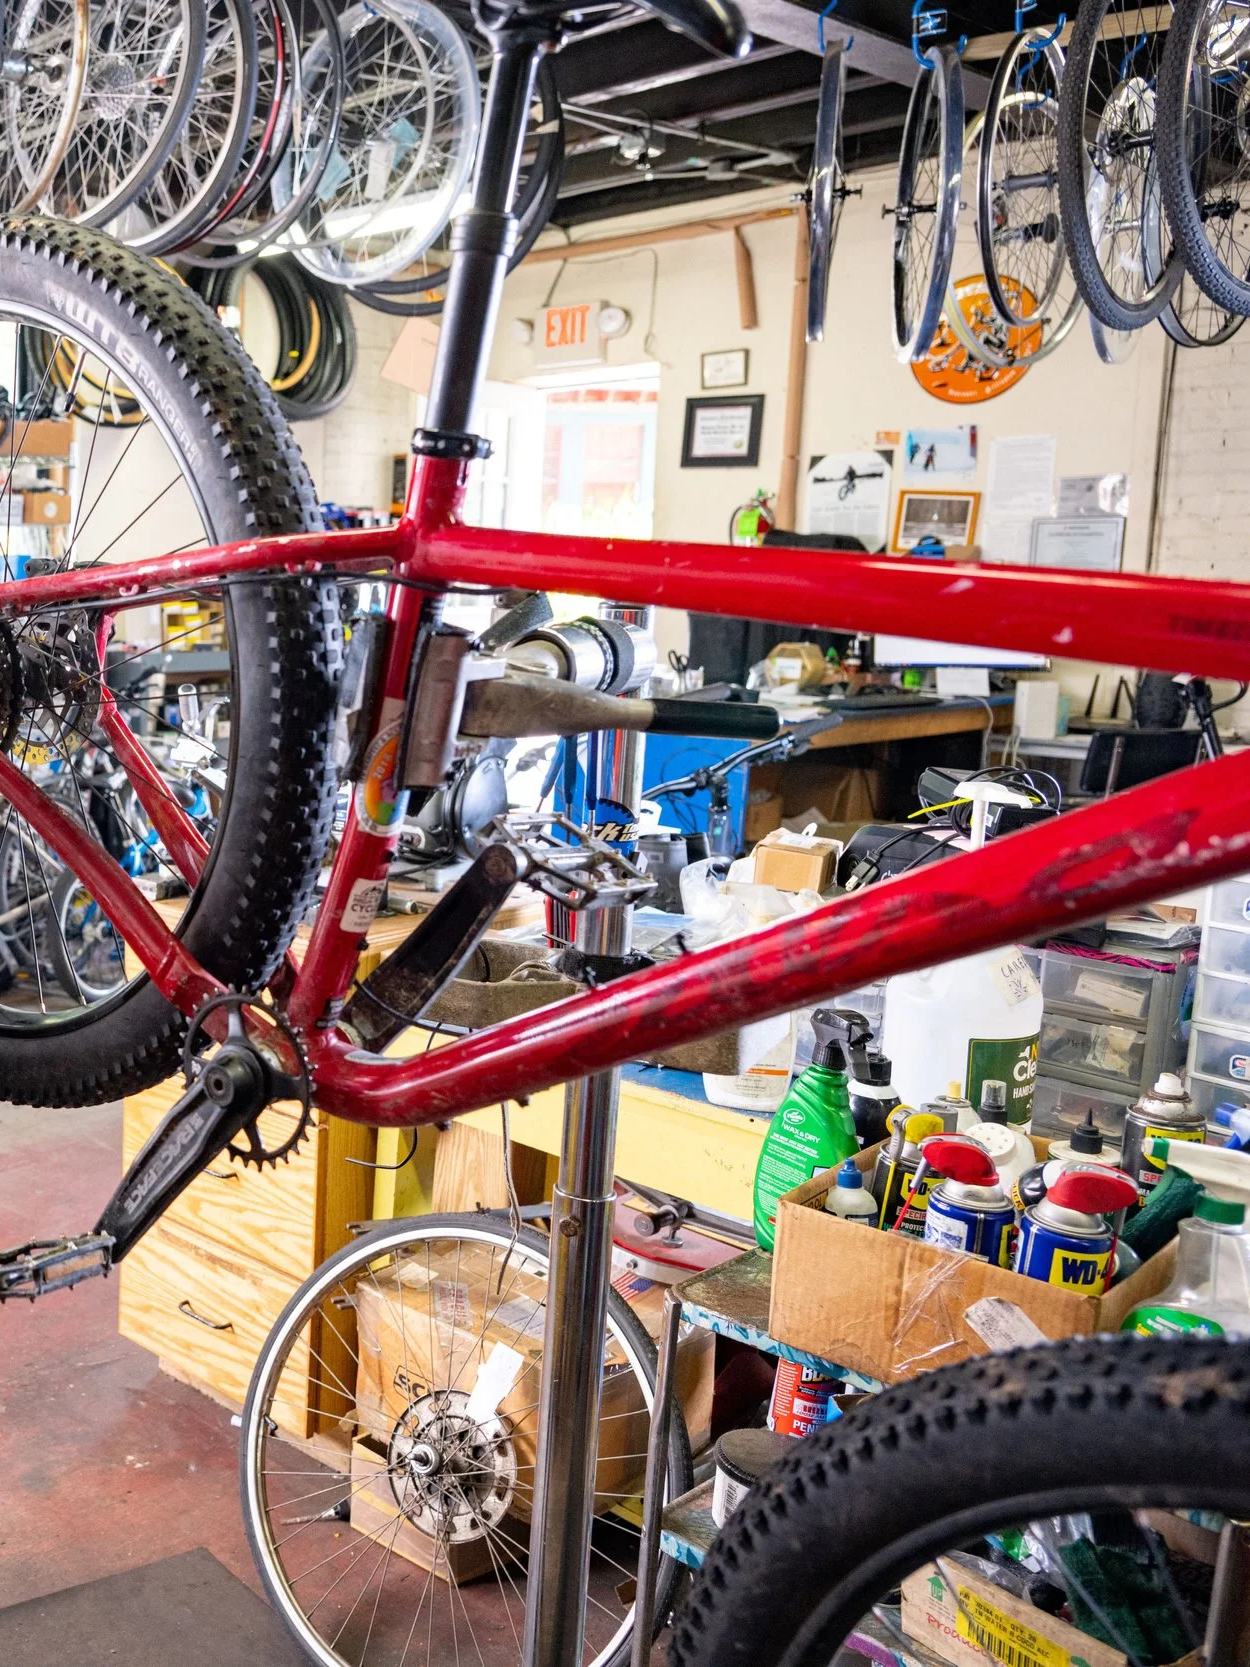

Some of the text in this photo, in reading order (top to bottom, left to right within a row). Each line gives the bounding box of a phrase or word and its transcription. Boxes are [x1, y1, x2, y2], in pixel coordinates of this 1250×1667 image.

[545, 304, 591, 347] EXIT
[783, 1123, 800, 1136] WAX
[804, 1131, 821, 1144] DRY
